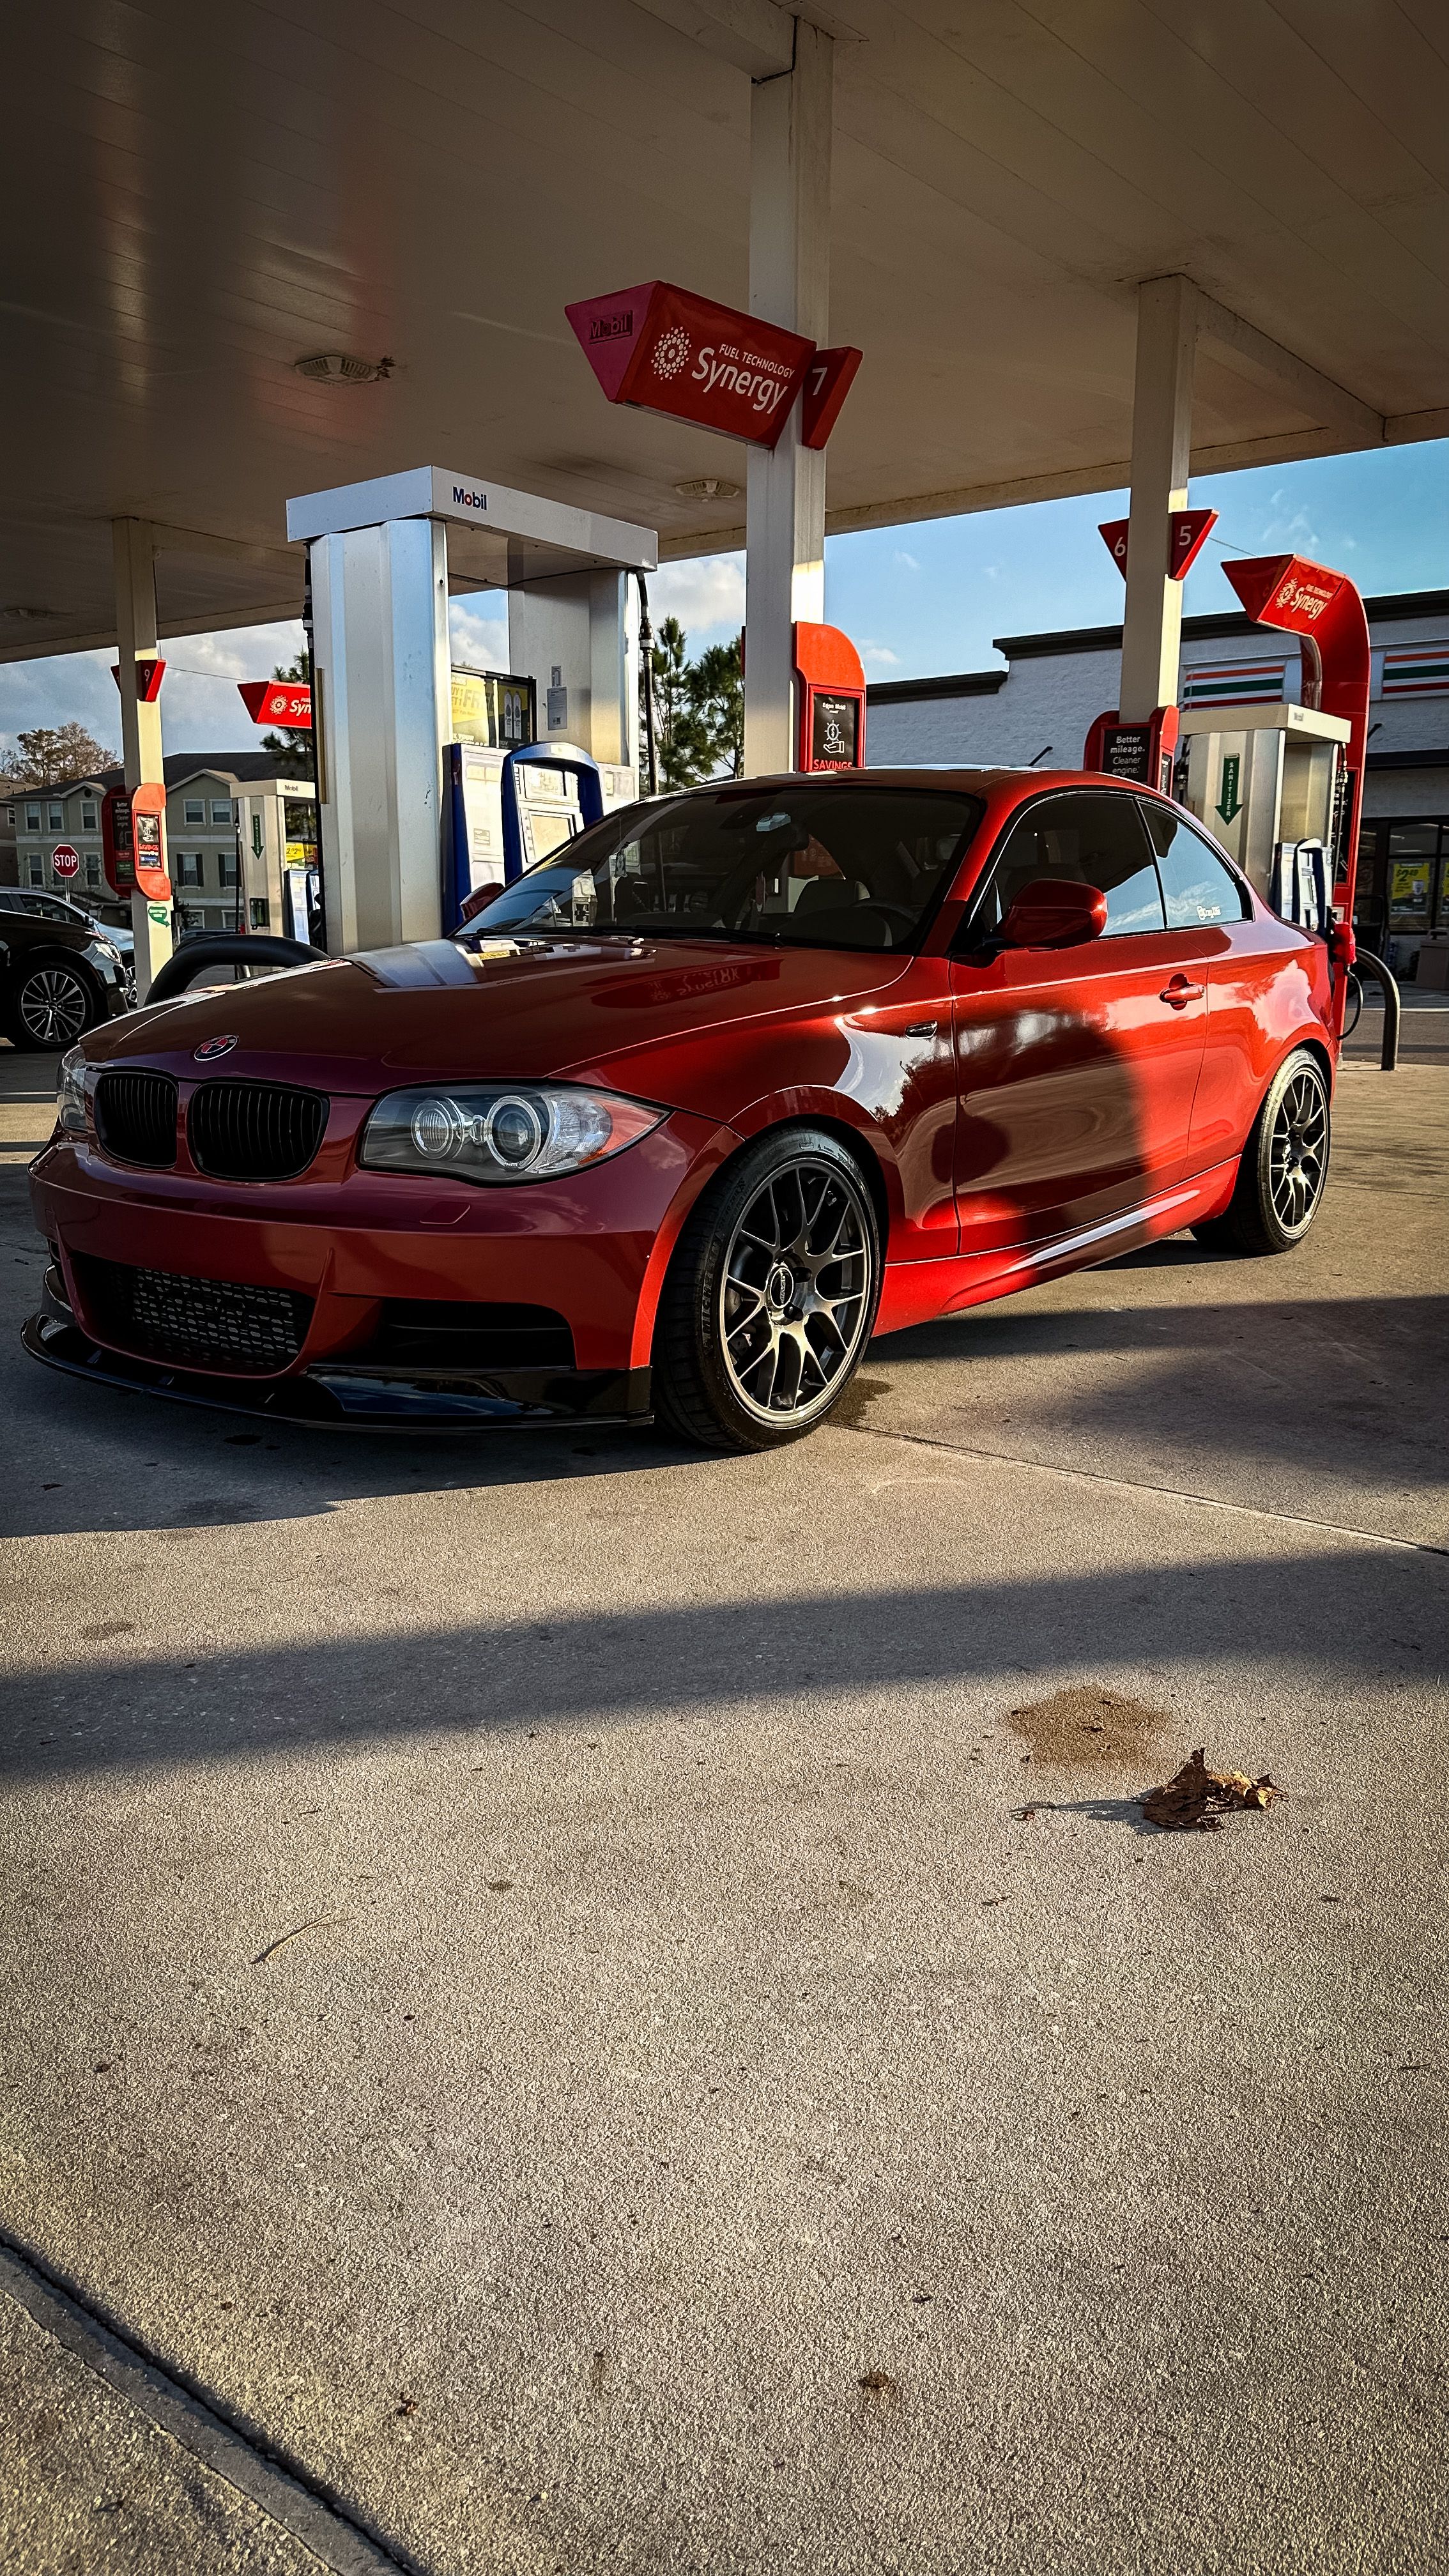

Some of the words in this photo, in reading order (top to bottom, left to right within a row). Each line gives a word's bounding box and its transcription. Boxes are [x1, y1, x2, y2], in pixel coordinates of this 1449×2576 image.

[589, 312, 631, 340] Mobil
[719, 343, 740, 360] FUEL
[742, 351, 795, 379] TECHNOLOGY
[691, 347, 789, 415] Synergy
[812, 367, 828, 395] 7
[452, 486, 487, 510] Mobil
[1114, 536, 1126, 556] 6
[1179, 525, 1192, 546] 5
[1289, 586, 1328, 620] Synergy
[144, 668, 150, 682] 9
[1110, 745, 1146, 755] mileage.
[1112, 756, 1141, 765] Cleaner
[813, 759, 853, 770] SAVINGS
[1226, 762, 1234, 816] SANITIZER
[54, 854, 77, 868] STOP
